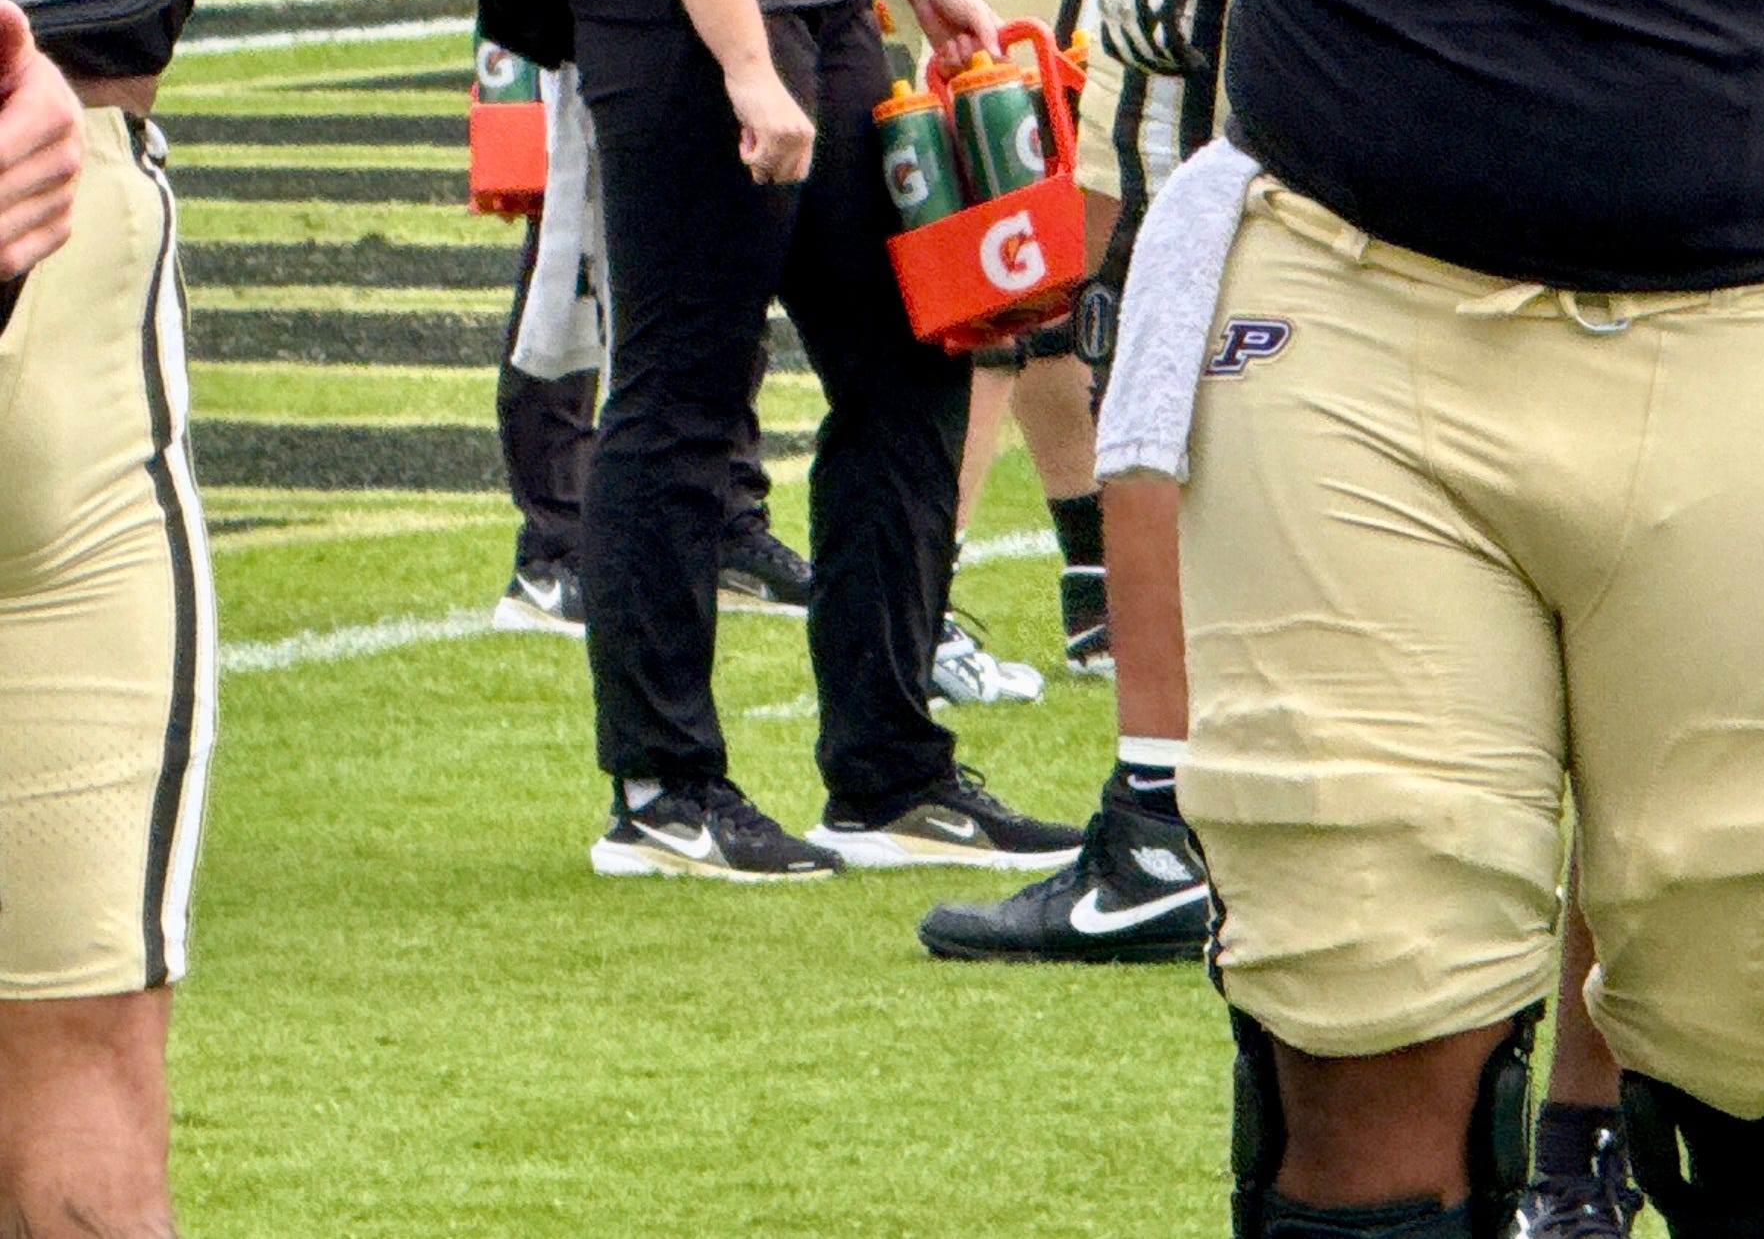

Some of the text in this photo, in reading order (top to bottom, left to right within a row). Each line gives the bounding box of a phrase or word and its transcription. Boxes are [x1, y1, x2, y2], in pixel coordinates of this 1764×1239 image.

[883, 145, 929, 210] G
[979, 209, 1047, 292] G
[1203, 317, 1293, 378] P
